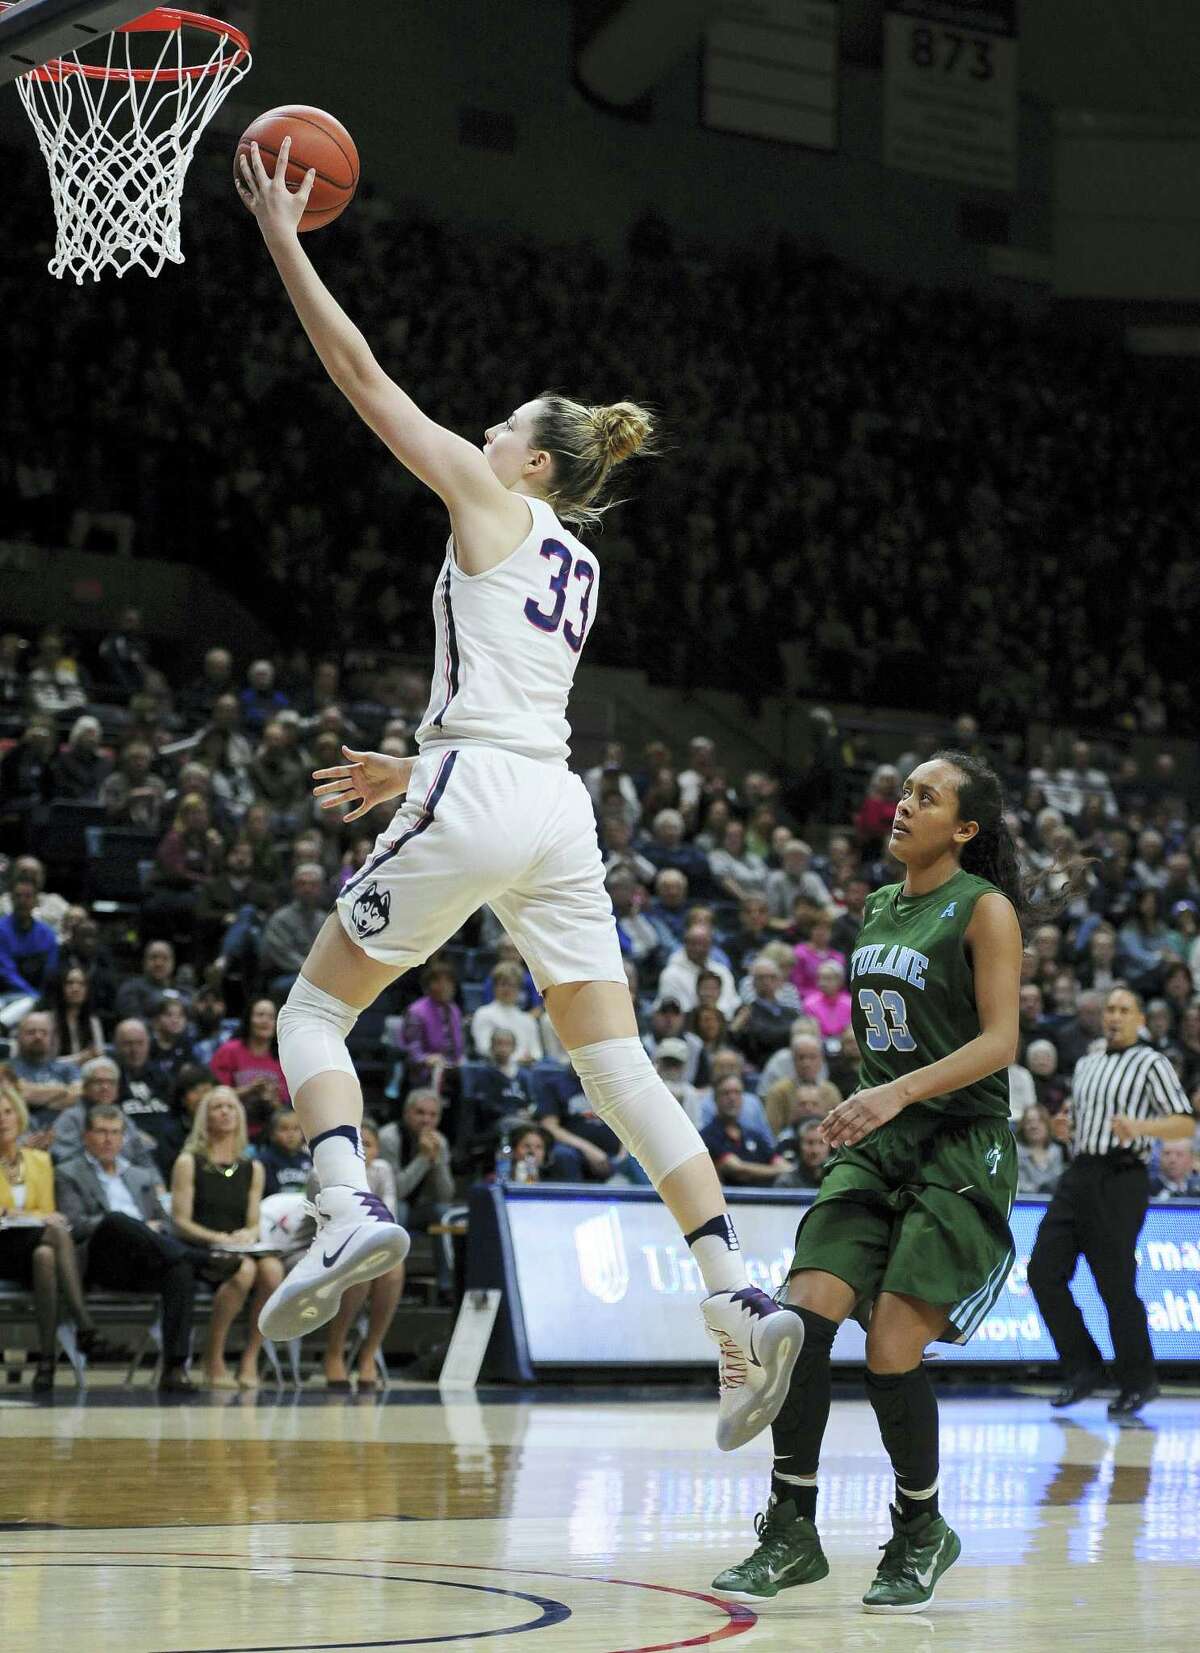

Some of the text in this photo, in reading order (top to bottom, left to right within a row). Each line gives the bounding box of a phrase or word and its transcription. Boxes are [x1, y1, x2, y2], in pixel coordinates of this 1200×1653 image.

[911, 27, 994, 81] 873
[523, 537, 595, 653] 33
[850, 943, 930, 991] TULANE
[858, 988, 918, 1052] 33
[642, 1246, 795, 1293] Uned
